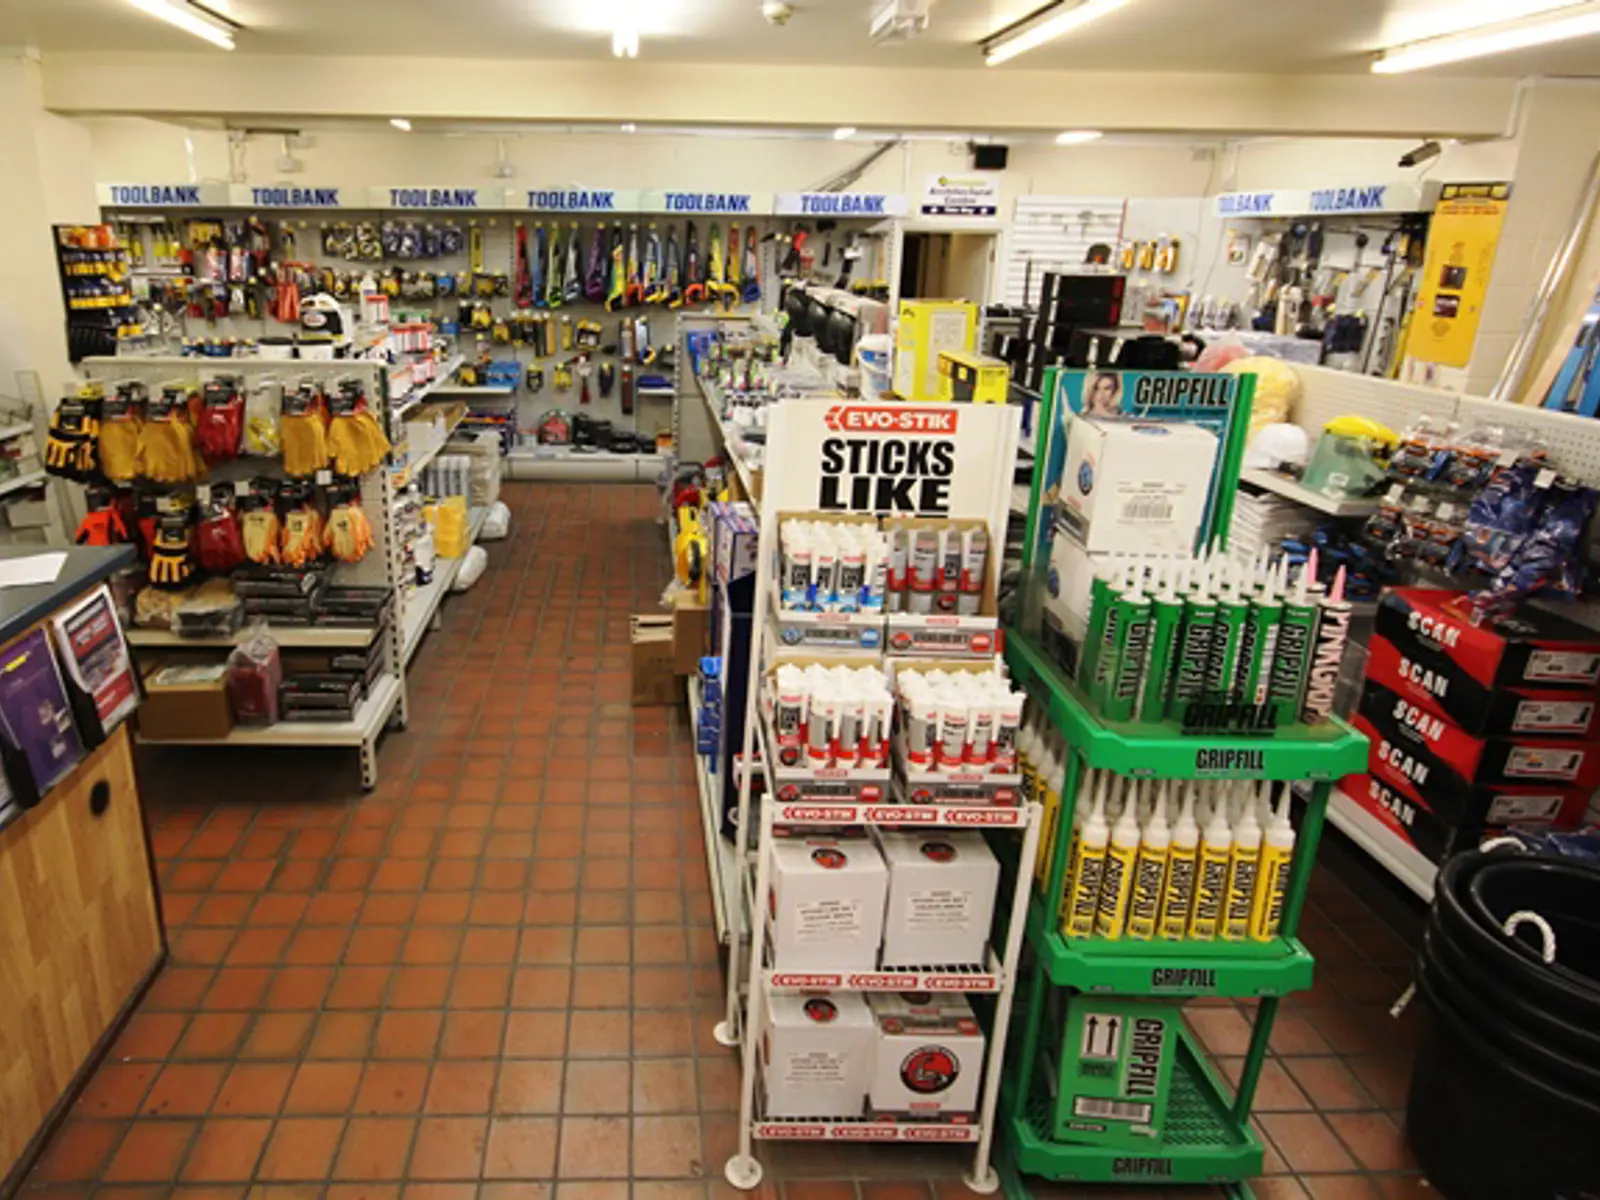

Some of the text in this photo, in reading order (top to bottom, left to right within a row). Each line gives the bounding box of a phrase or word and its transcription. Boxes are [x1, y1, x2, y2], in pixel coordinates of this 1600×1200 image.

[110, 186, 200, 204] TOOLBANK
[251, 188, 339, 206] TOOLBANK
[390, 188, 478, 207] TOOLBANK
[527, 191, 614, 209] TOOLBANK
[664, 193, 751, 212] TOOLBANK
[801, 195, 885, 213] TOOLBANK
[1134, 376, 1231, 405] GRIPFILL
[846, 409, 951, 430] EVO-STIK
[822, 439, 955, 476] STICKS
[819, 476, 949, 512] LIKE
[1406, 611, 1462, 649] SCAN
[1397, 656, 1450, 698] SCAN
[1392, 699, 1447, 742] SCAN
[1196, 749, 1264, 770] GRIPFILL
[1377, 739, 1430, 786] SCAN
[1368, 778, 1417, 827] SCAN
[1152, 967, 1216, 987] GRIPFILL
[1127, 1018, 1164, 1097] GRIPFILL
[1112, 1157, 1173, 1176] GRIPFILL
